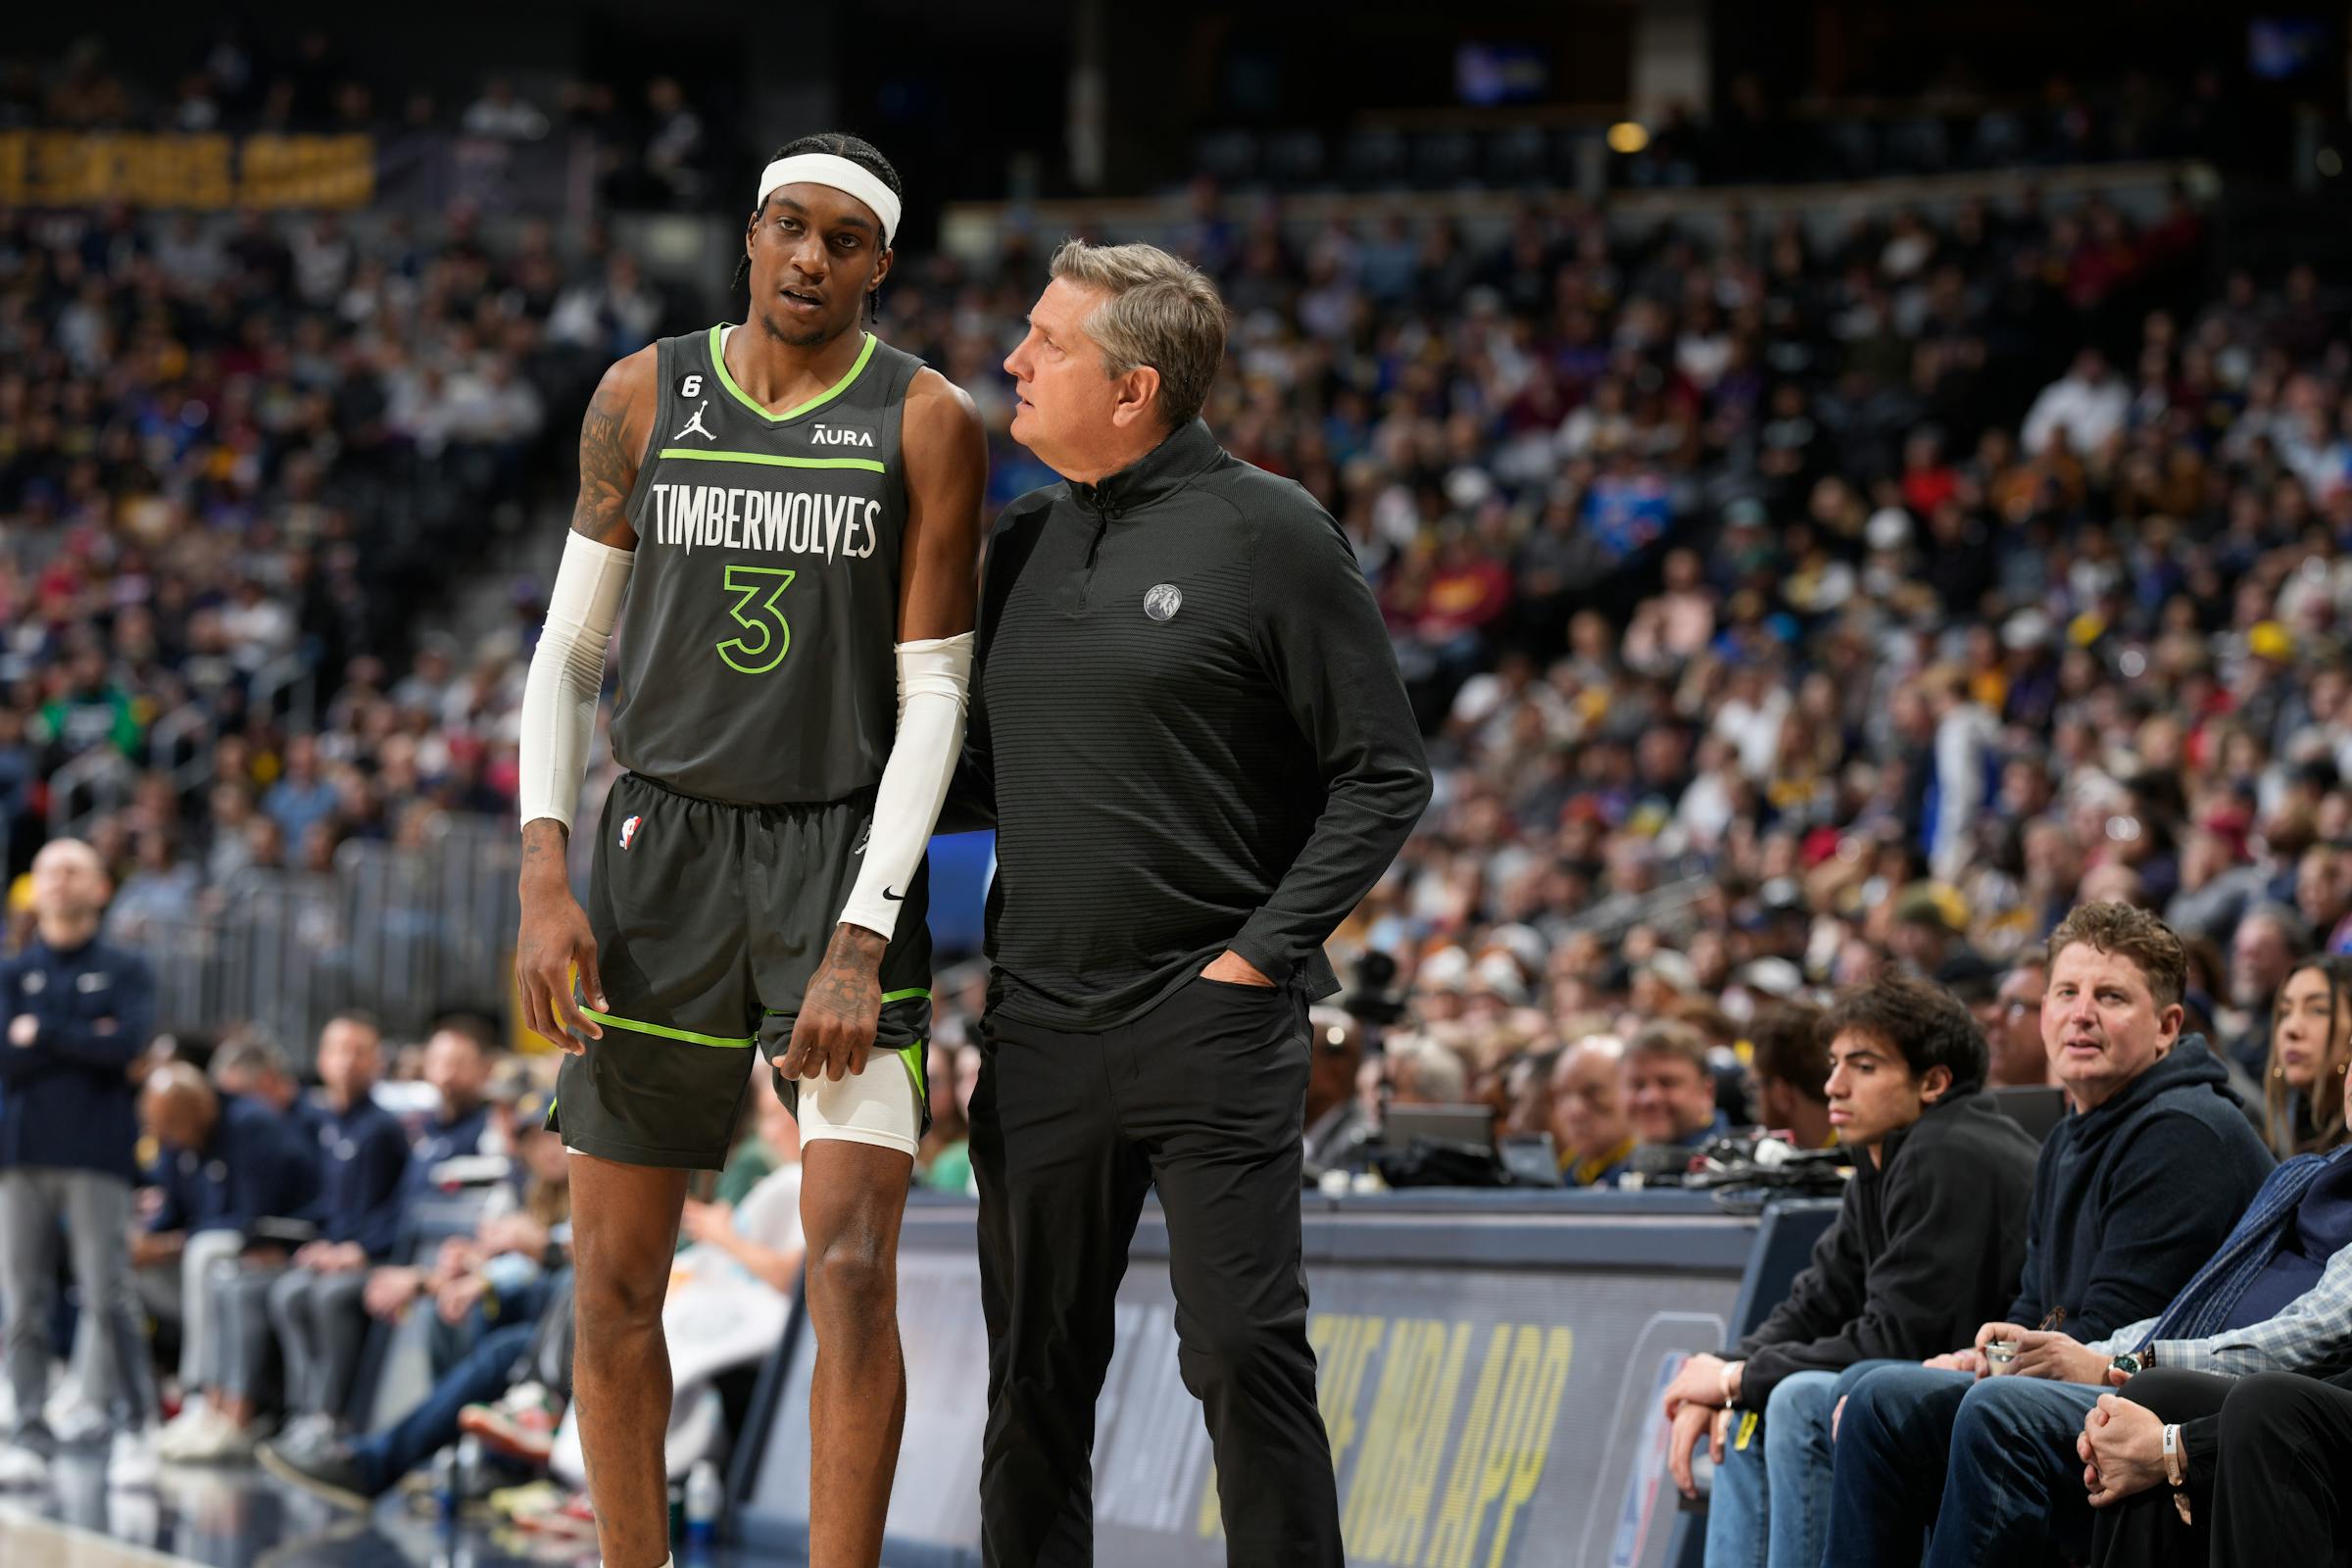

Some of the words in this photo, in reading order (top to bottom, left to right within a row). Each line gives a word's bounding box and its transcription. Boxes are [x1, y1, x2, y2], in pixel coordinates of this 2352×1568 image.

[681, 374, 703, 397] 6
[653, 484, 882, 565] TIMBERWOLVES
[716, 564, 796, 674] 3
[1345, 1317, 1472, 1565] NBA
[1423, 1322, 1574, 1568] APP
